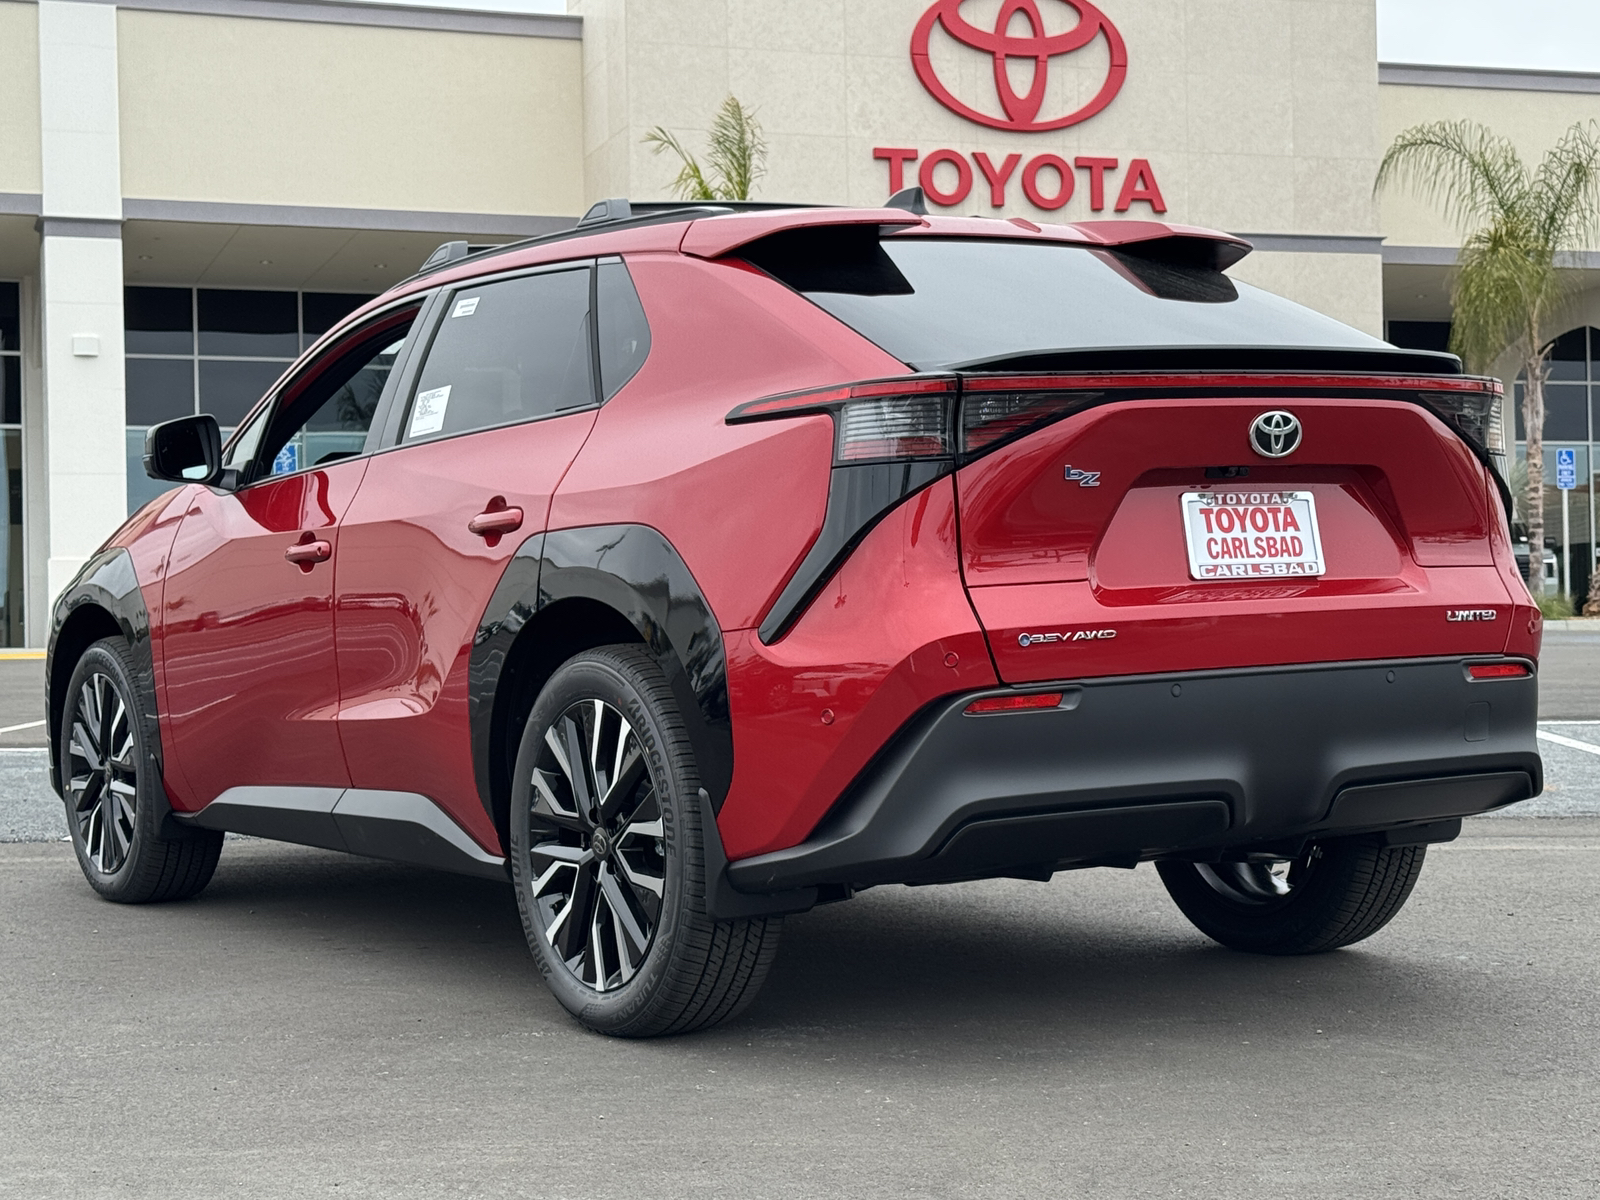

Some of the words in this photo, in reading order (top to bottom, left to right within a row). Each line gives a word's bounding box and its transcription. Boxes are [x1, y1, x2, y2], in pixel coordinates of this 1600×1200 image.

[873, 148, 1167, 213] TOYOTA
[1215, 493, 1282, 505] TOYOTA
[1199, 507, 1301, 533] TOYOTA
[1206, 536, 1303, 559] CARLSBAD
[1200, 562, 1318, 577] CARLSBAD
[1446, 610, 1497, 622] LIMITED
[1030, 632, 1072, 643] BEV
[1072, 629, 1117, 641] AWD
[627, 698, 678, 858] BRIDGESTONE
[607, 973, 658, 1023] TURANZ
